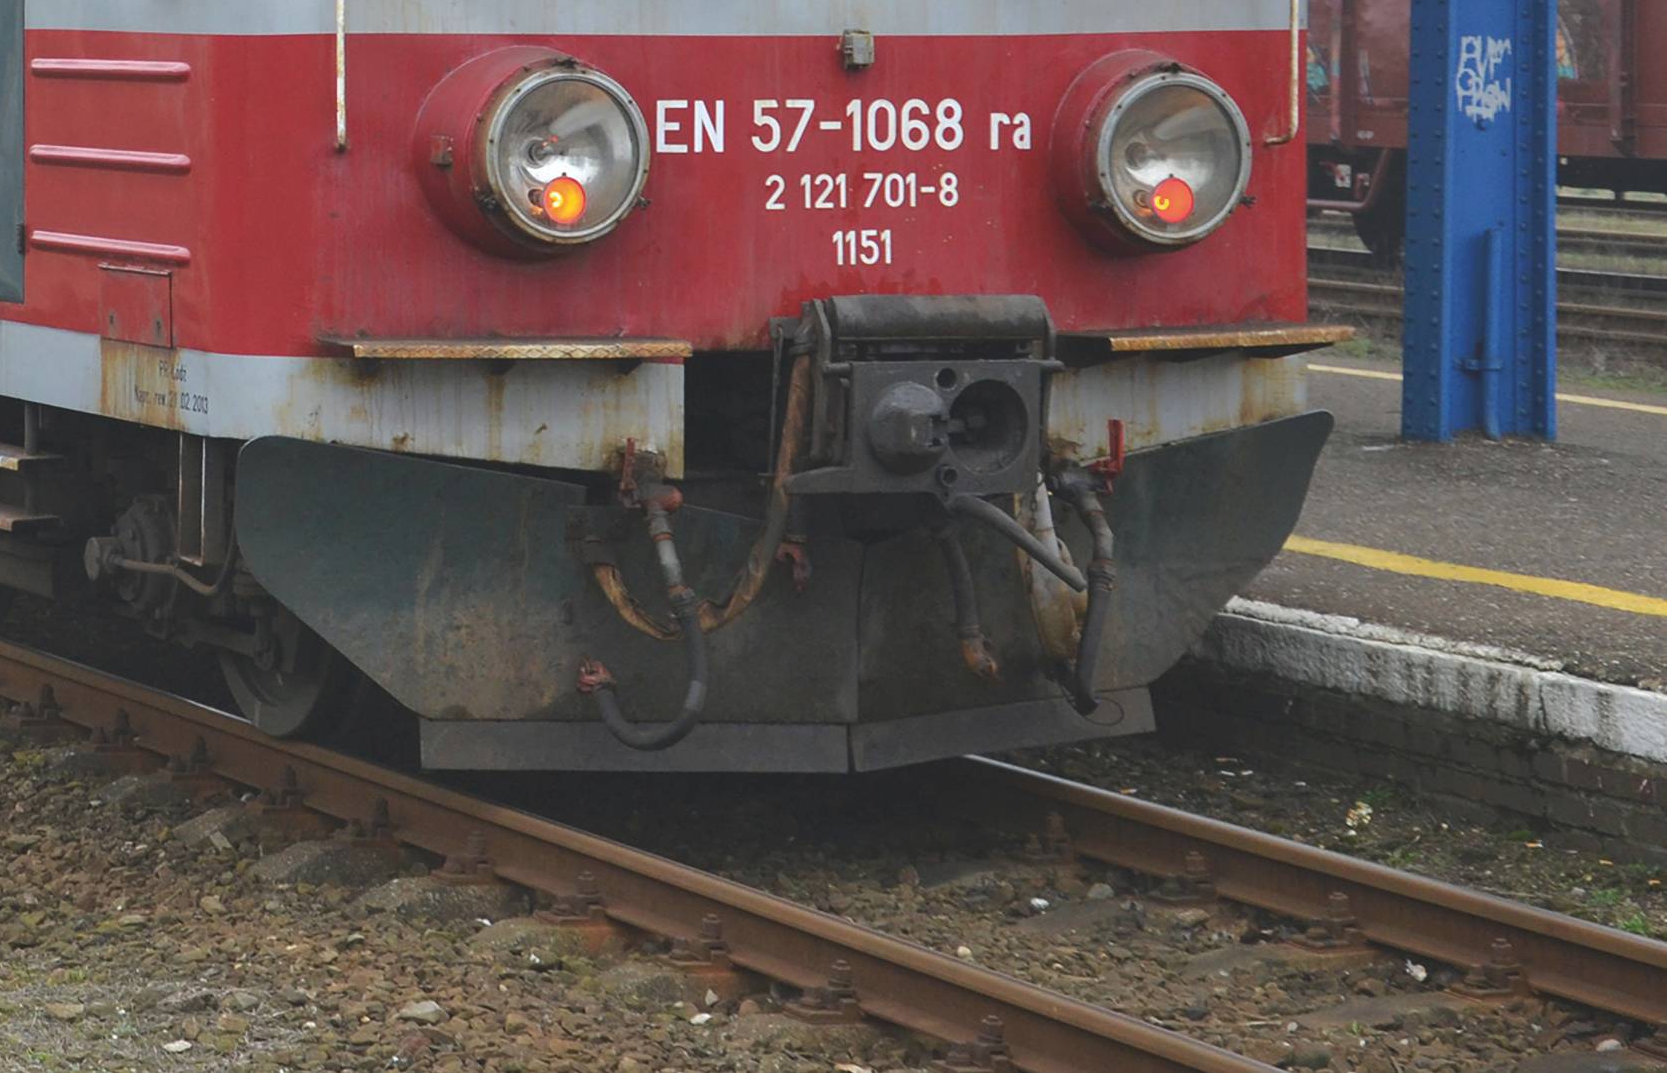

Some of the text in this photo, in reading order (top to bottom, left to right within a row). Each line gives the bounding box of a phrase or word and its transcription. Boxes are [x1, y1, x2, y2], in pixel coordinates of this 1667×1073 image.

[656, 99, 1032, 153] EN 57-1068 ra
[765, 172, 959, 210] 2 121 701-8
[832, 229, 892, 266] 1151
